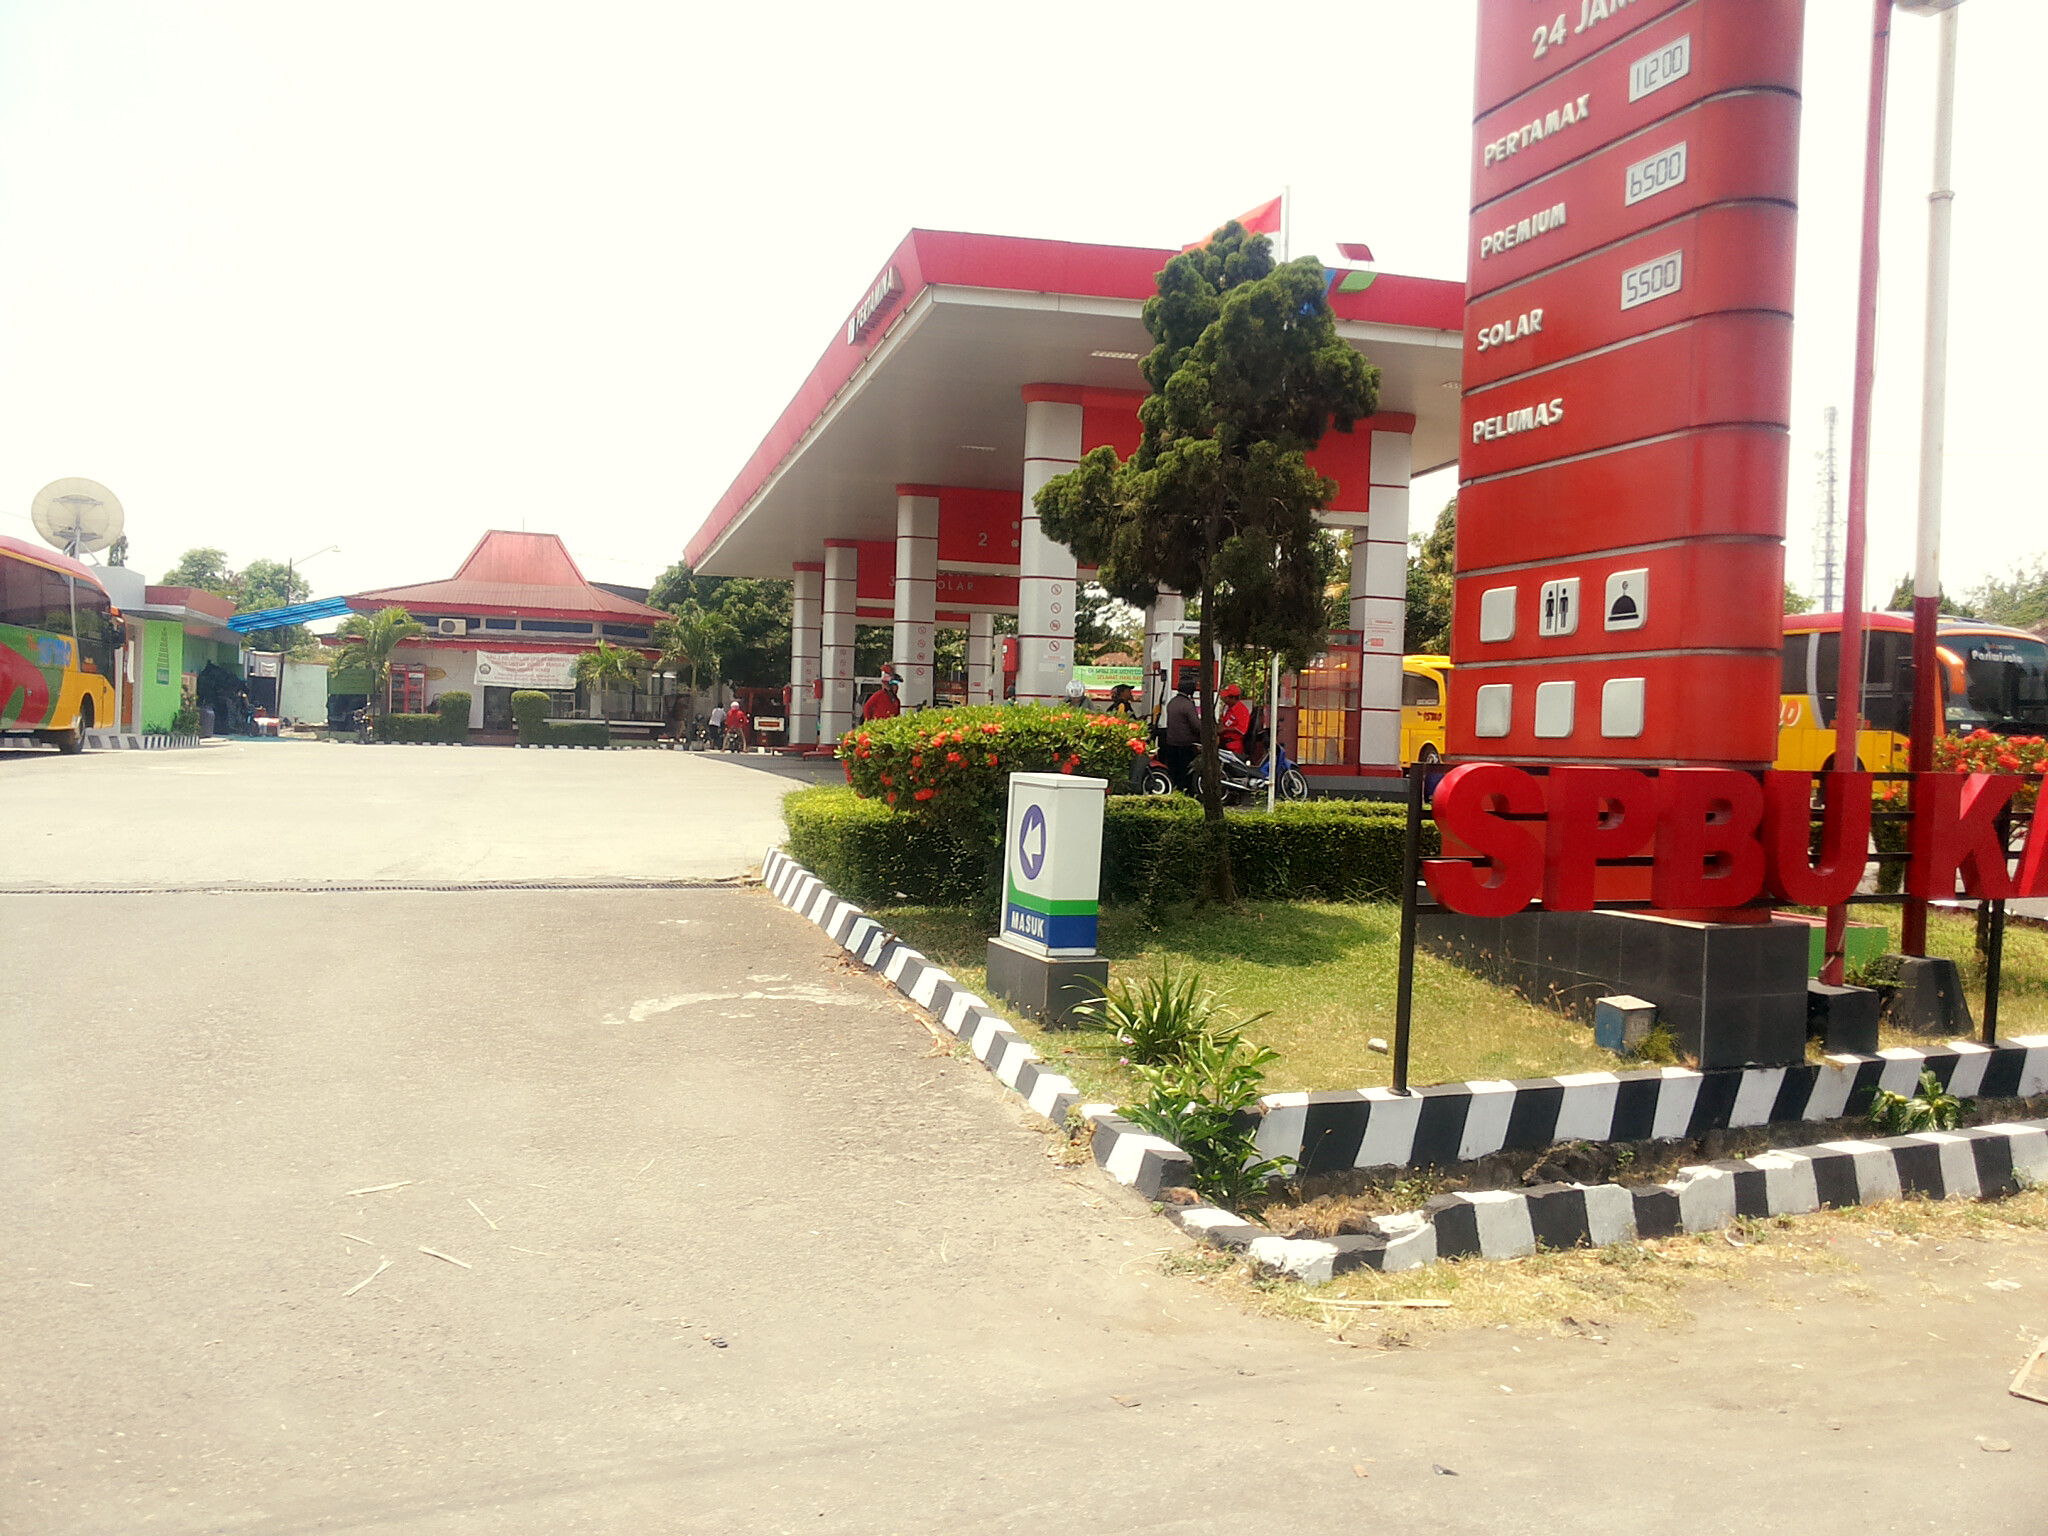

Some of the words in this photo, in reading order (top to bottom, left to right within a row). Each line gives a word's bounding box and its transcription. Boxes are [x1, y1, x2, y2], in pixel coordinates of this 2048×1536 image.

[1531, 13, 1568, 60] 24
[1636, 45, 1683, 92] 11200
[1483, 93, 1590, 168] PERTAMAX
[1630, 151, 1681, 198] 6500
[1480, 202, 1567, 259] PREMIUM
[1626, 259, 1678, 303] 5500
[1477, 308, 1544, 352] SOLAR
[1472, 398, 1565, 444] PELUMAS
[977, 532, 988, 547] 2
[936, 579, 974, 592] OLAR
[1423, 762, 1874, 918] SPBU
[1010, 910, 1045, 939] MASUK
